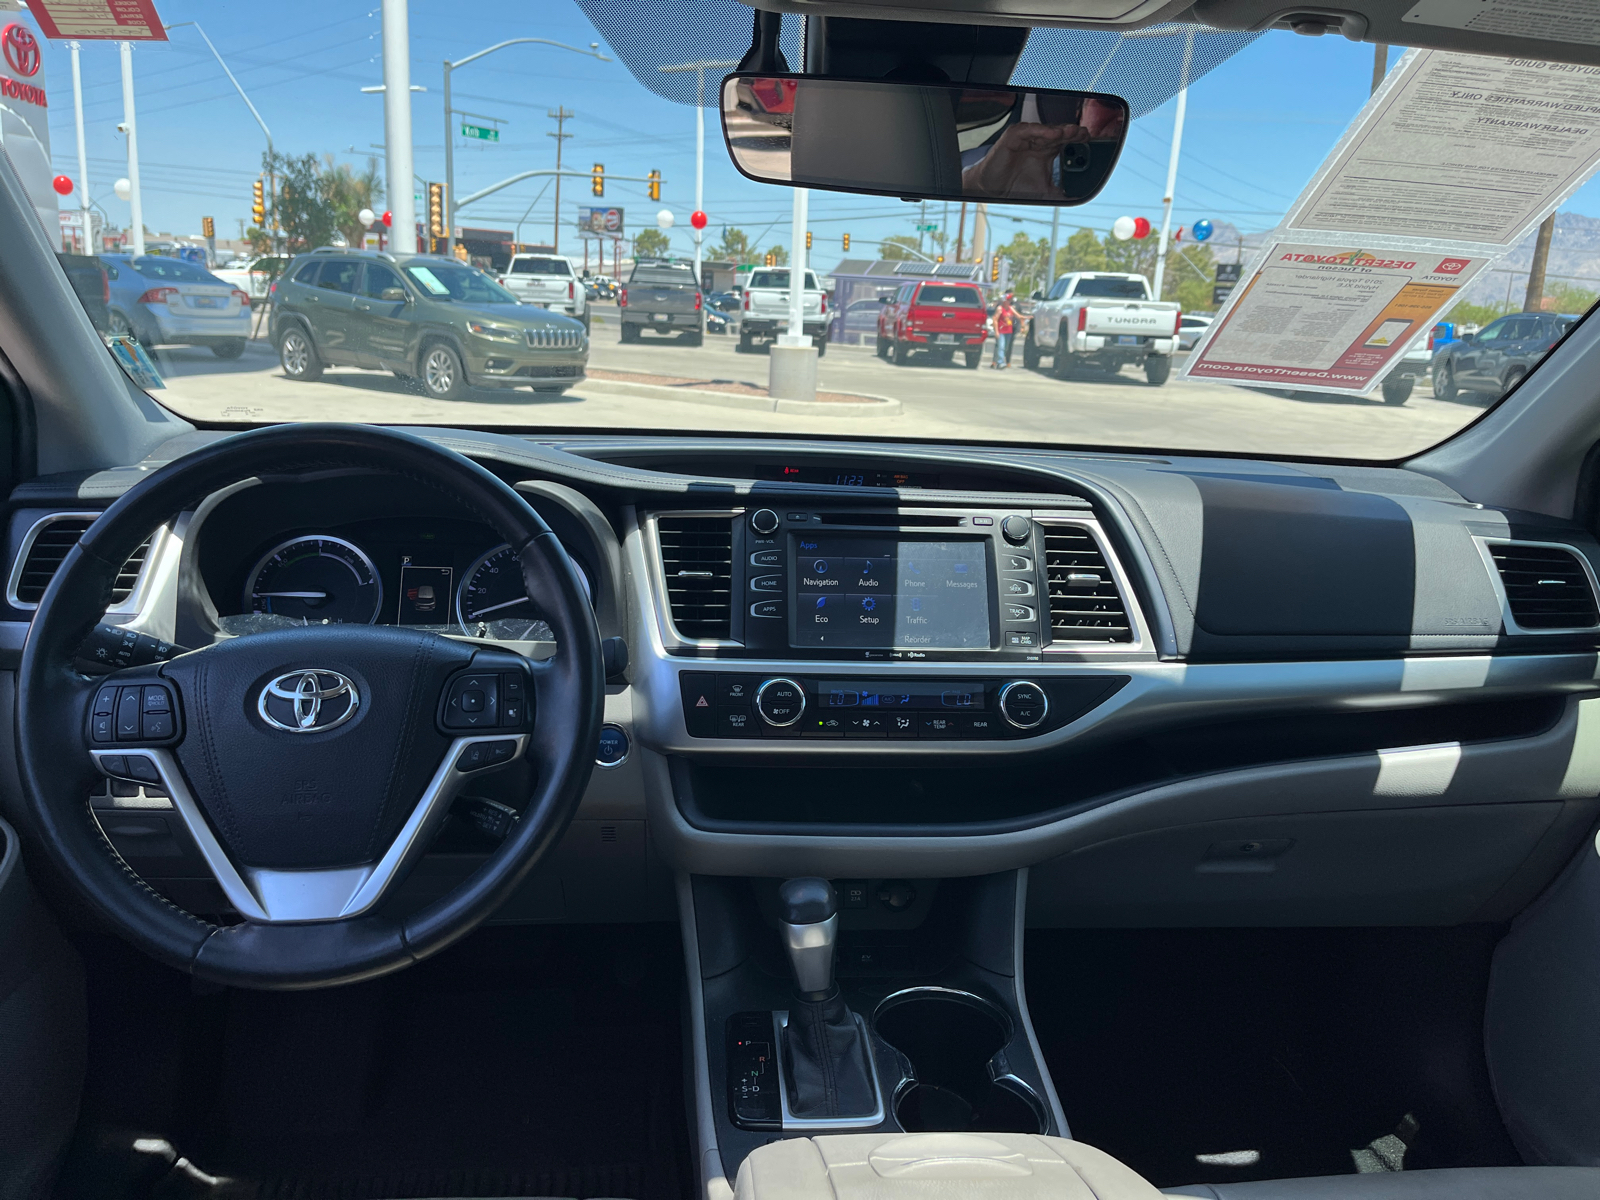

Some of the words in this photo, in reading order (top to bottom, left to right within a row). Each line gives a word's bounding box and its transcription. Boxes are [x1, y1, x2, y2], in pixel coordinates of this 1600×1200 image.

[0, 76, 48, 108] TOYOTA
[800, 541, 818, 549] Apps
[803, 578, 839, 587] Navigation
[946, 580, 978, 588] Messages
[860, 615, 880, 624] Setup
[906, 616, 928, 624] Traffic
